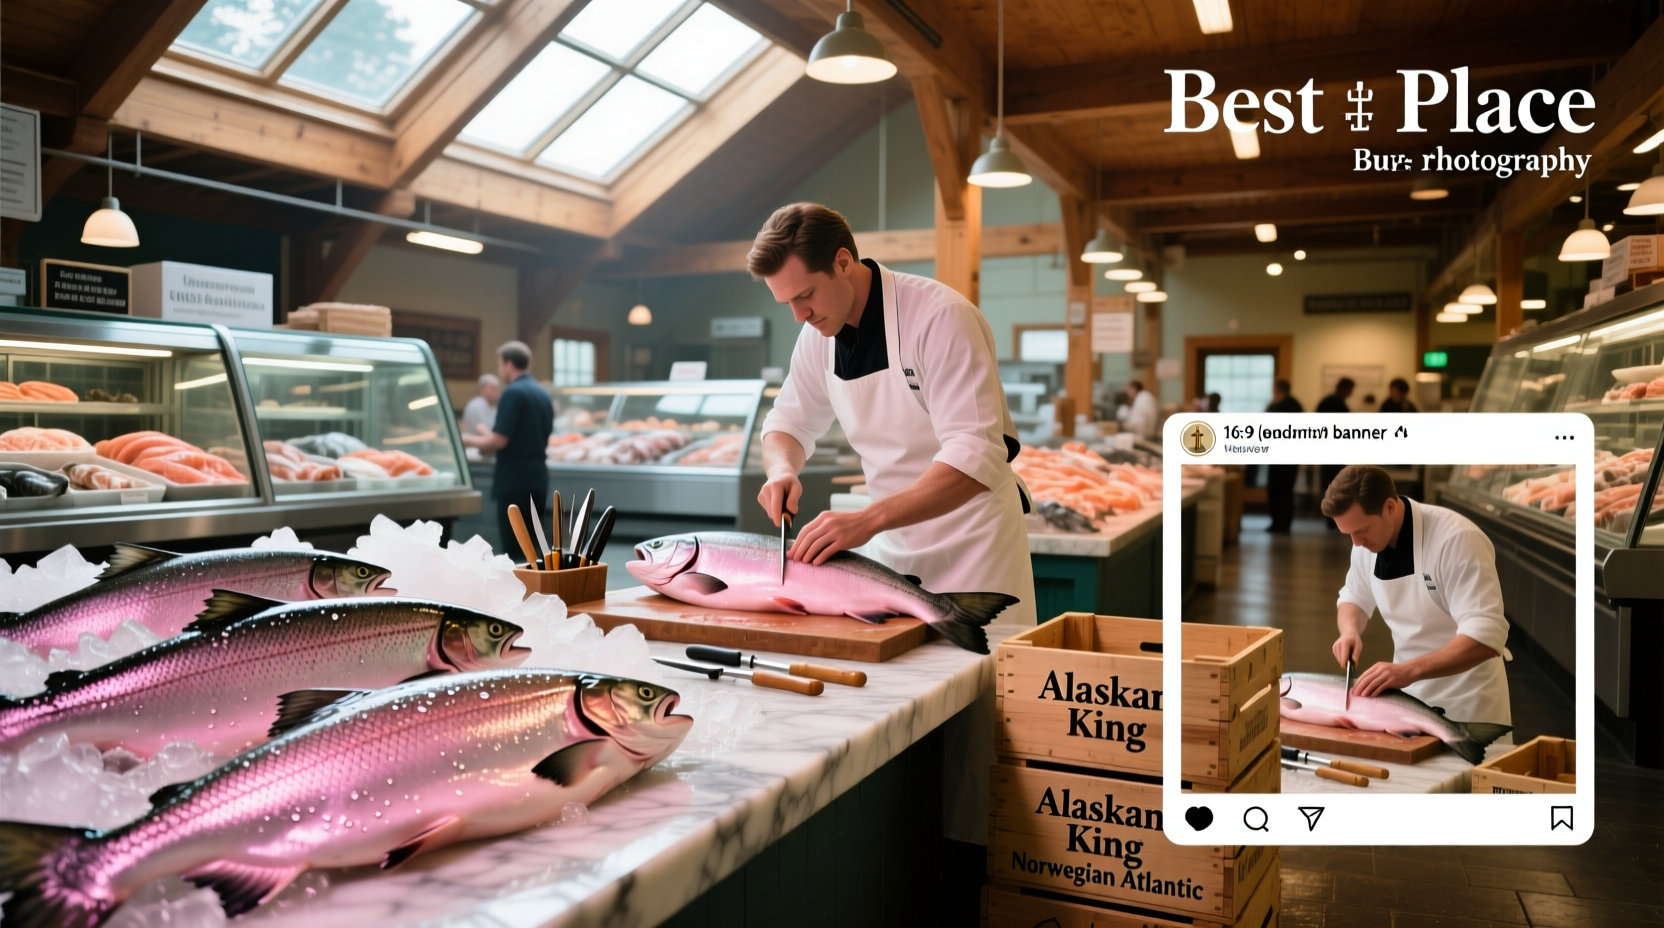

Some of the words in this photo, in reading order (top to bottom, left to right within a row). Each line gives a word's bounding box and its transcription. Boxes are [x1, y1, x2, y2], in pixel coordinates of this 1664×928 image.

[1067, 708, 1147, 753] King
[1035, 787, 1163, 831] Alaskan
[1066, 824, 1144, 870] King
[1011, 851, 1116, 887] Norwegian
[1120, 870, 1204, 901] Atlantic
